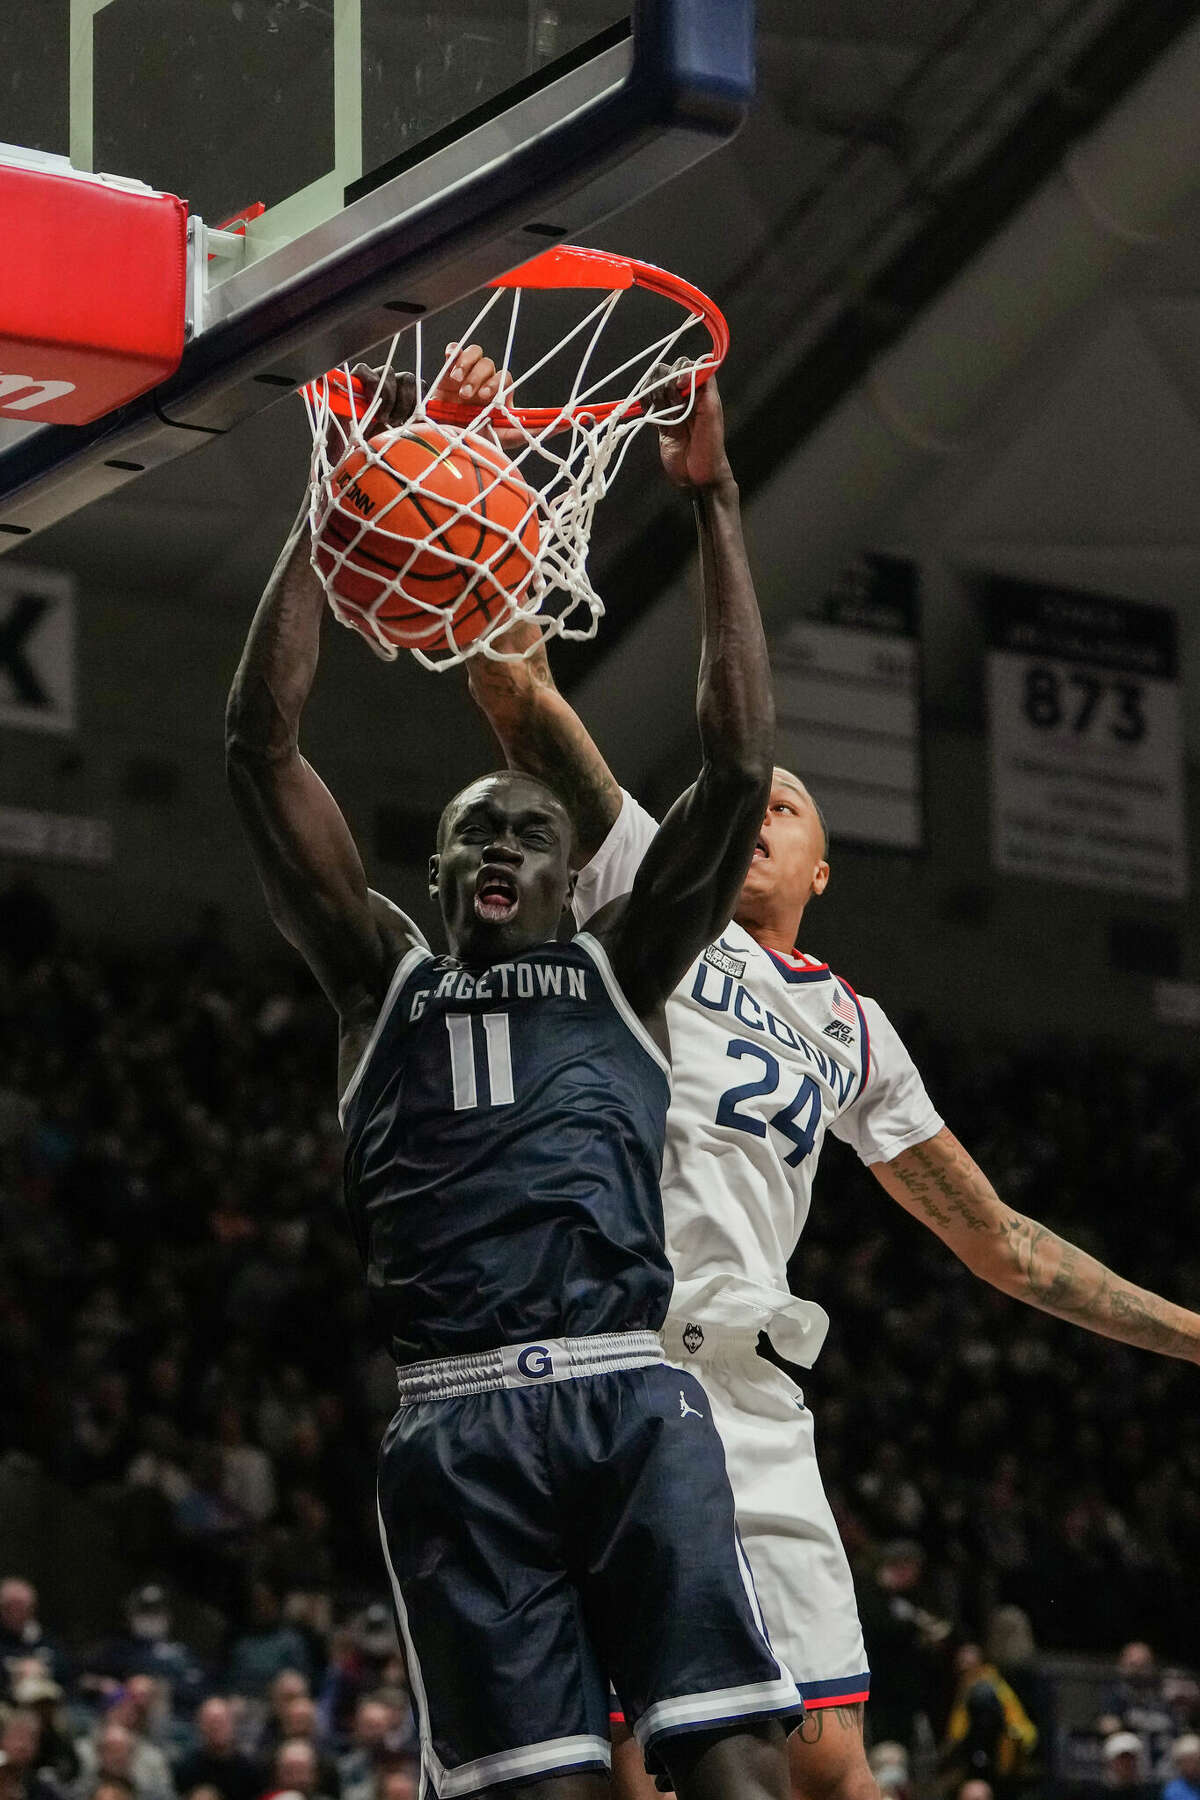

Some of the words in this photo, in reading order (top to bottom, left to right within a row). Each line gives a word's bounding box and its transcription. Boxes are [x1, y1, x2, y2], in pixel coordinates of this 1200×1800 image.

[1025, 668, 1147, 742] 873
[706, 952, 742, 976] CHANGE
[691, 962, 855, 1108] UCONN
[824, 1024, 855, 1044] EAST
[830, 1019, 853, 1034] BIG
[446, 1012, 515, 1111] 11
[715, 1039, 821, 1168] 24
[517, 1345, 554, 1379] G
